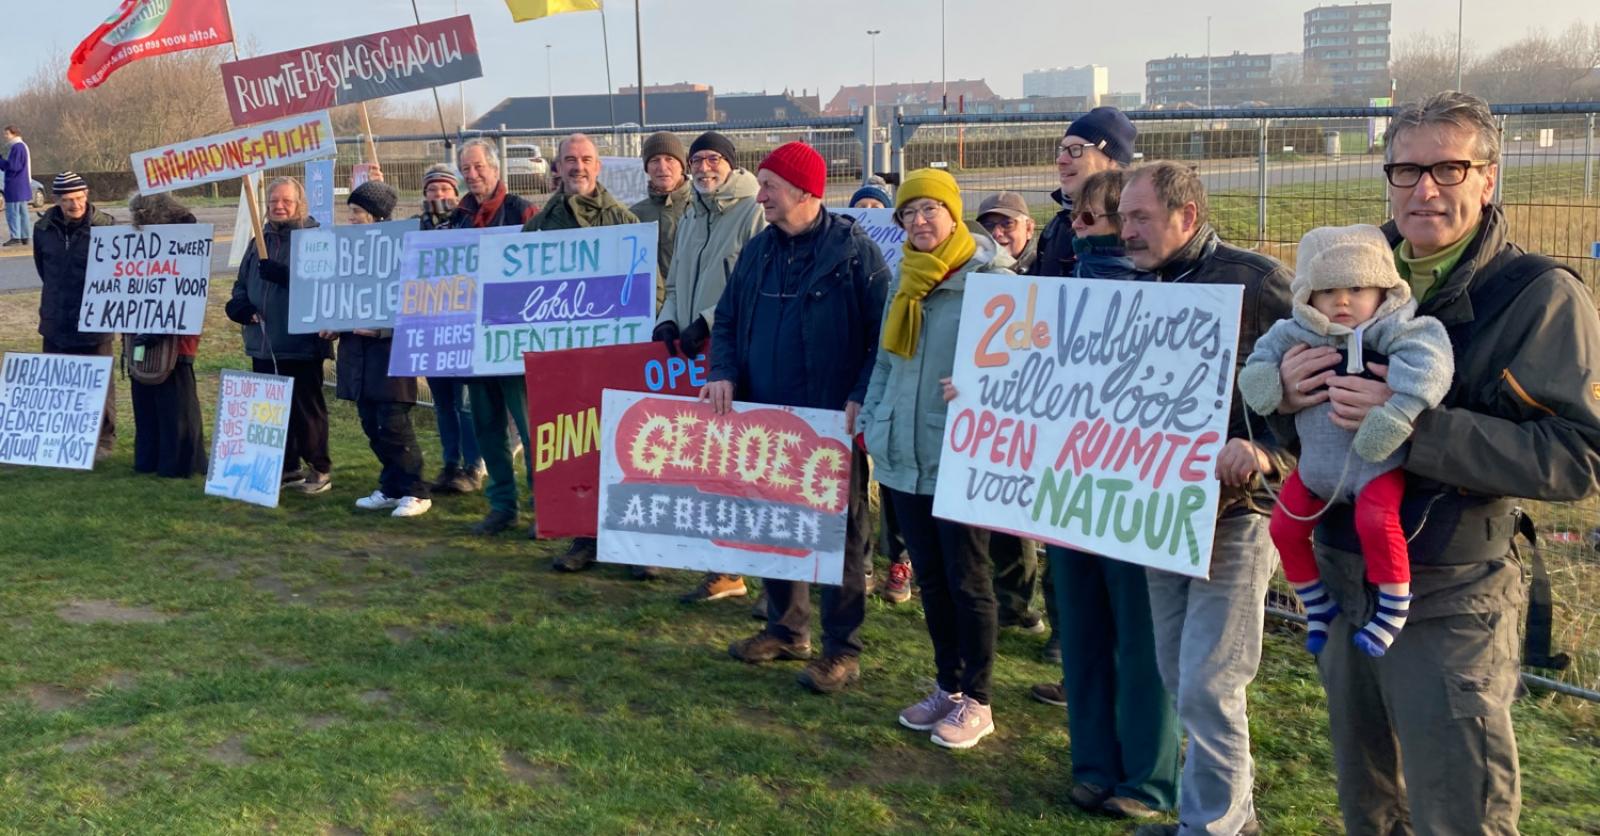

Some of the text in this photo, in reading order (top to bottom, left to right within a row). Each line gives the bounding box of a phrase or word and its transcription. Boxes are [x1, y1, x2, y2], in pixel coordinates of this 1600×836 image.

[233, 30, 462, 113] RUIMTEBESLAGSCHADUW
[111, 232, 162, 260] STAD
[169, 238, 213, 258] ZWEERT
[305, 242, 329, 253] HIER
[113, 259, 180, 277] SOCIAAL
[502, 235, 648, 306] STEUN Je
[87, 278, 207, 297] MAAR BUIGT VOOR
[302, 280, 401, 323] JUNGLE
[518, 280, 614, 322] lokale
[100, 299, 187, 330] KAPITAAL
[406, 323, 476, 348] TE HERS
[974, 282, 1222, 404] 2de Verblijvers
[410, 353, 429, 373] TE
[11, 387, 86, 411] GROOTSTE
[265, 383, 285, 401] VAN
[978, 351, 1101, 421] willen
[0, 432, 40, 463] ATUUR
[57, 433, 94, 466] KUST
[247, 423, 286, 449] GROEN
[950, 408, 1220, 489] OPEN RUIMTE
[628, 408, 846, 512] GENOEG
[965, 466, 1207, 566] voor NATUUR
